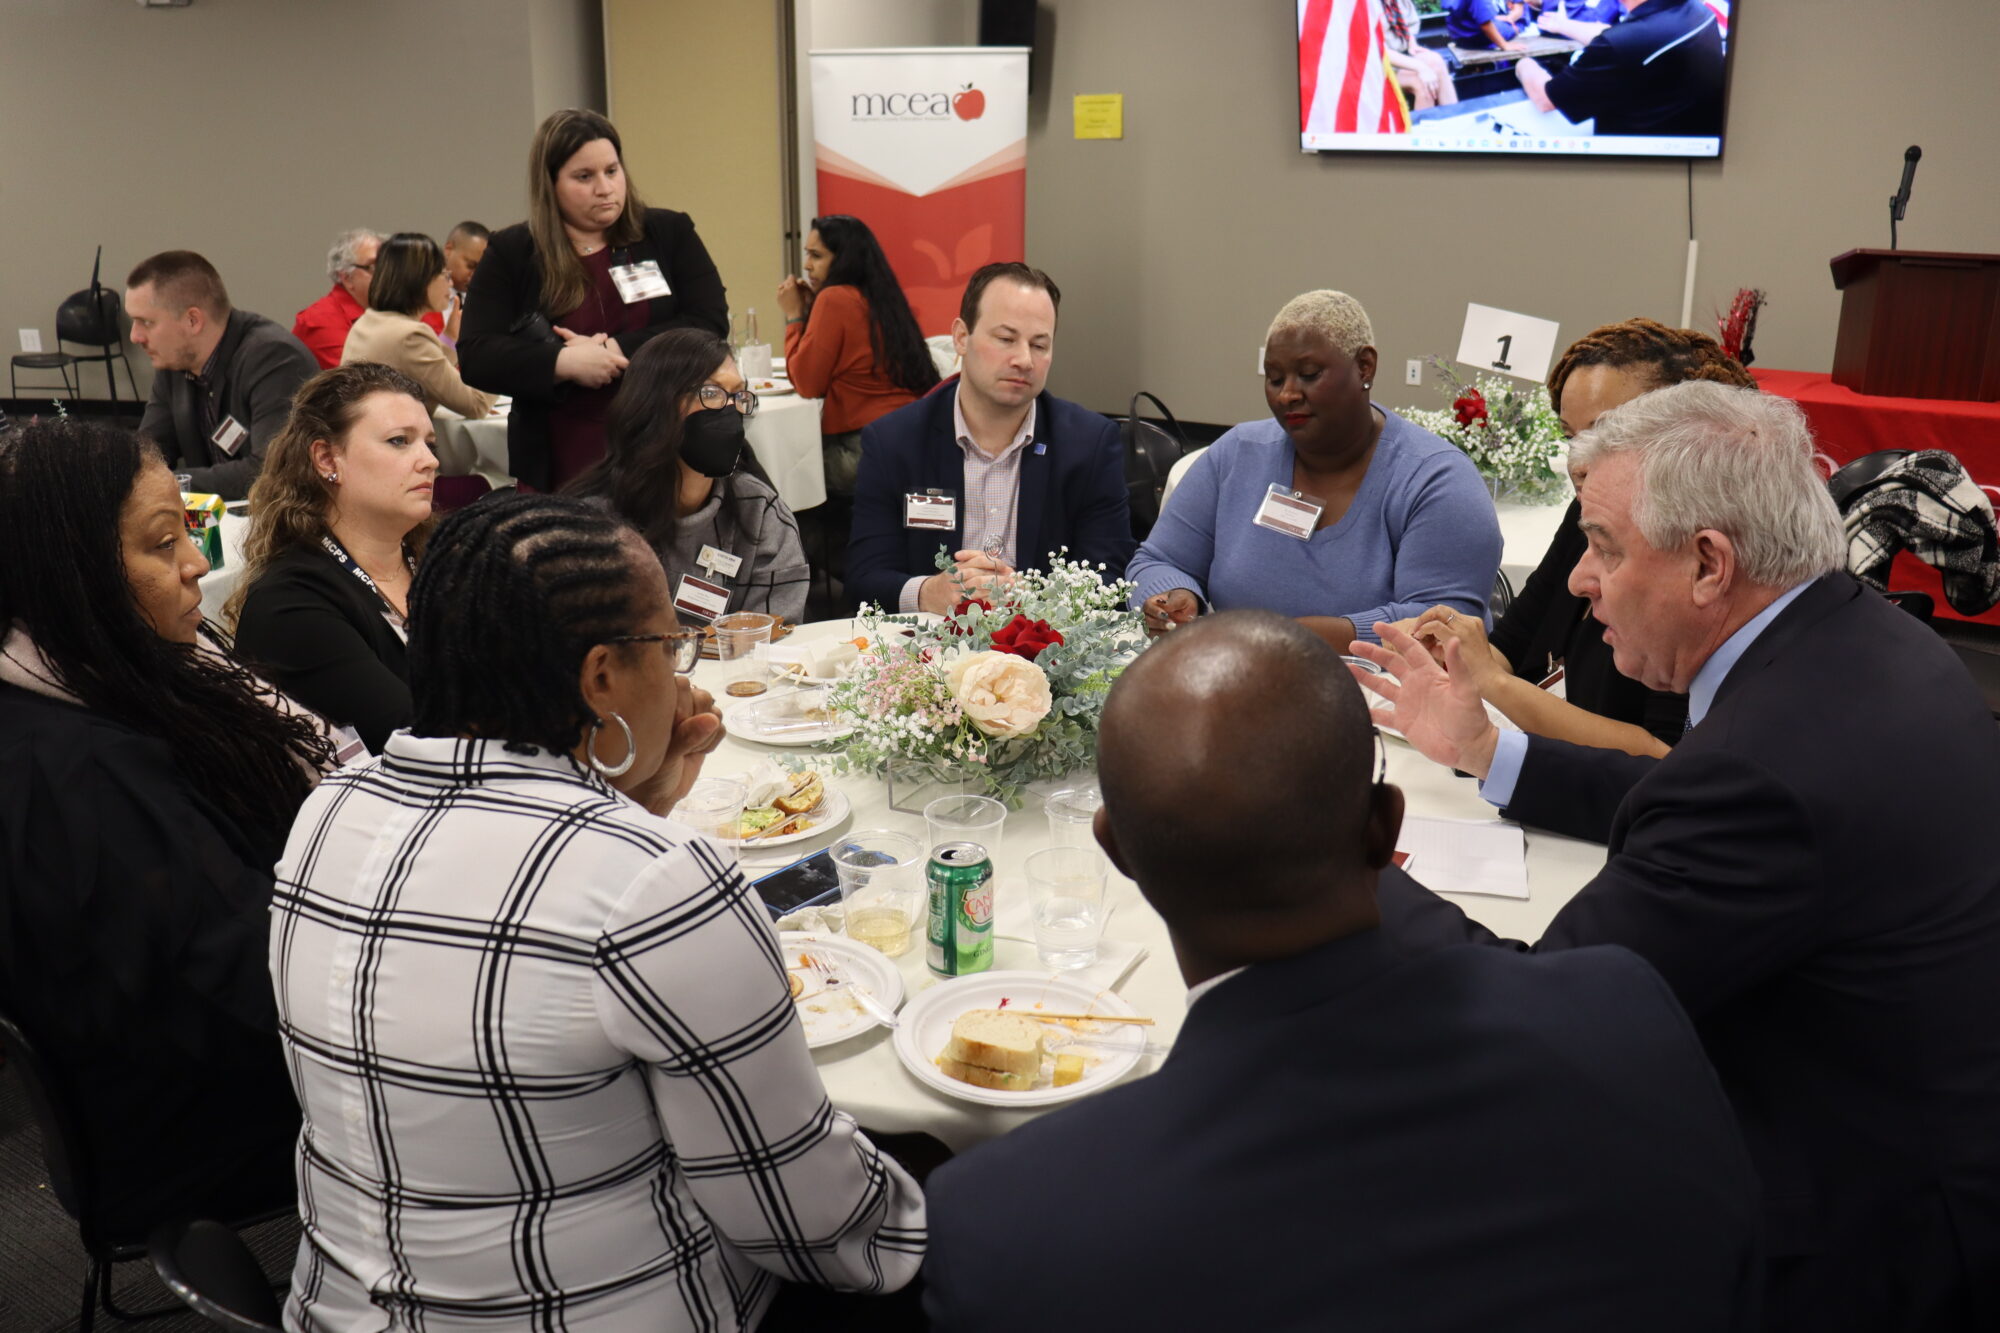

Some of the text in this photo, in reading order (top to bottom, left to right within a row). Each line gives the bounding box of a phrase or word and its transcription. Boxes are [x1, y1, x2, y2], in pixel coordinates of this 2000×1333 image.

[852, 92, 950, 116] mcea
[1493, 335, 1512, 370] 1
[321, 537, 348, 563] MCPS
